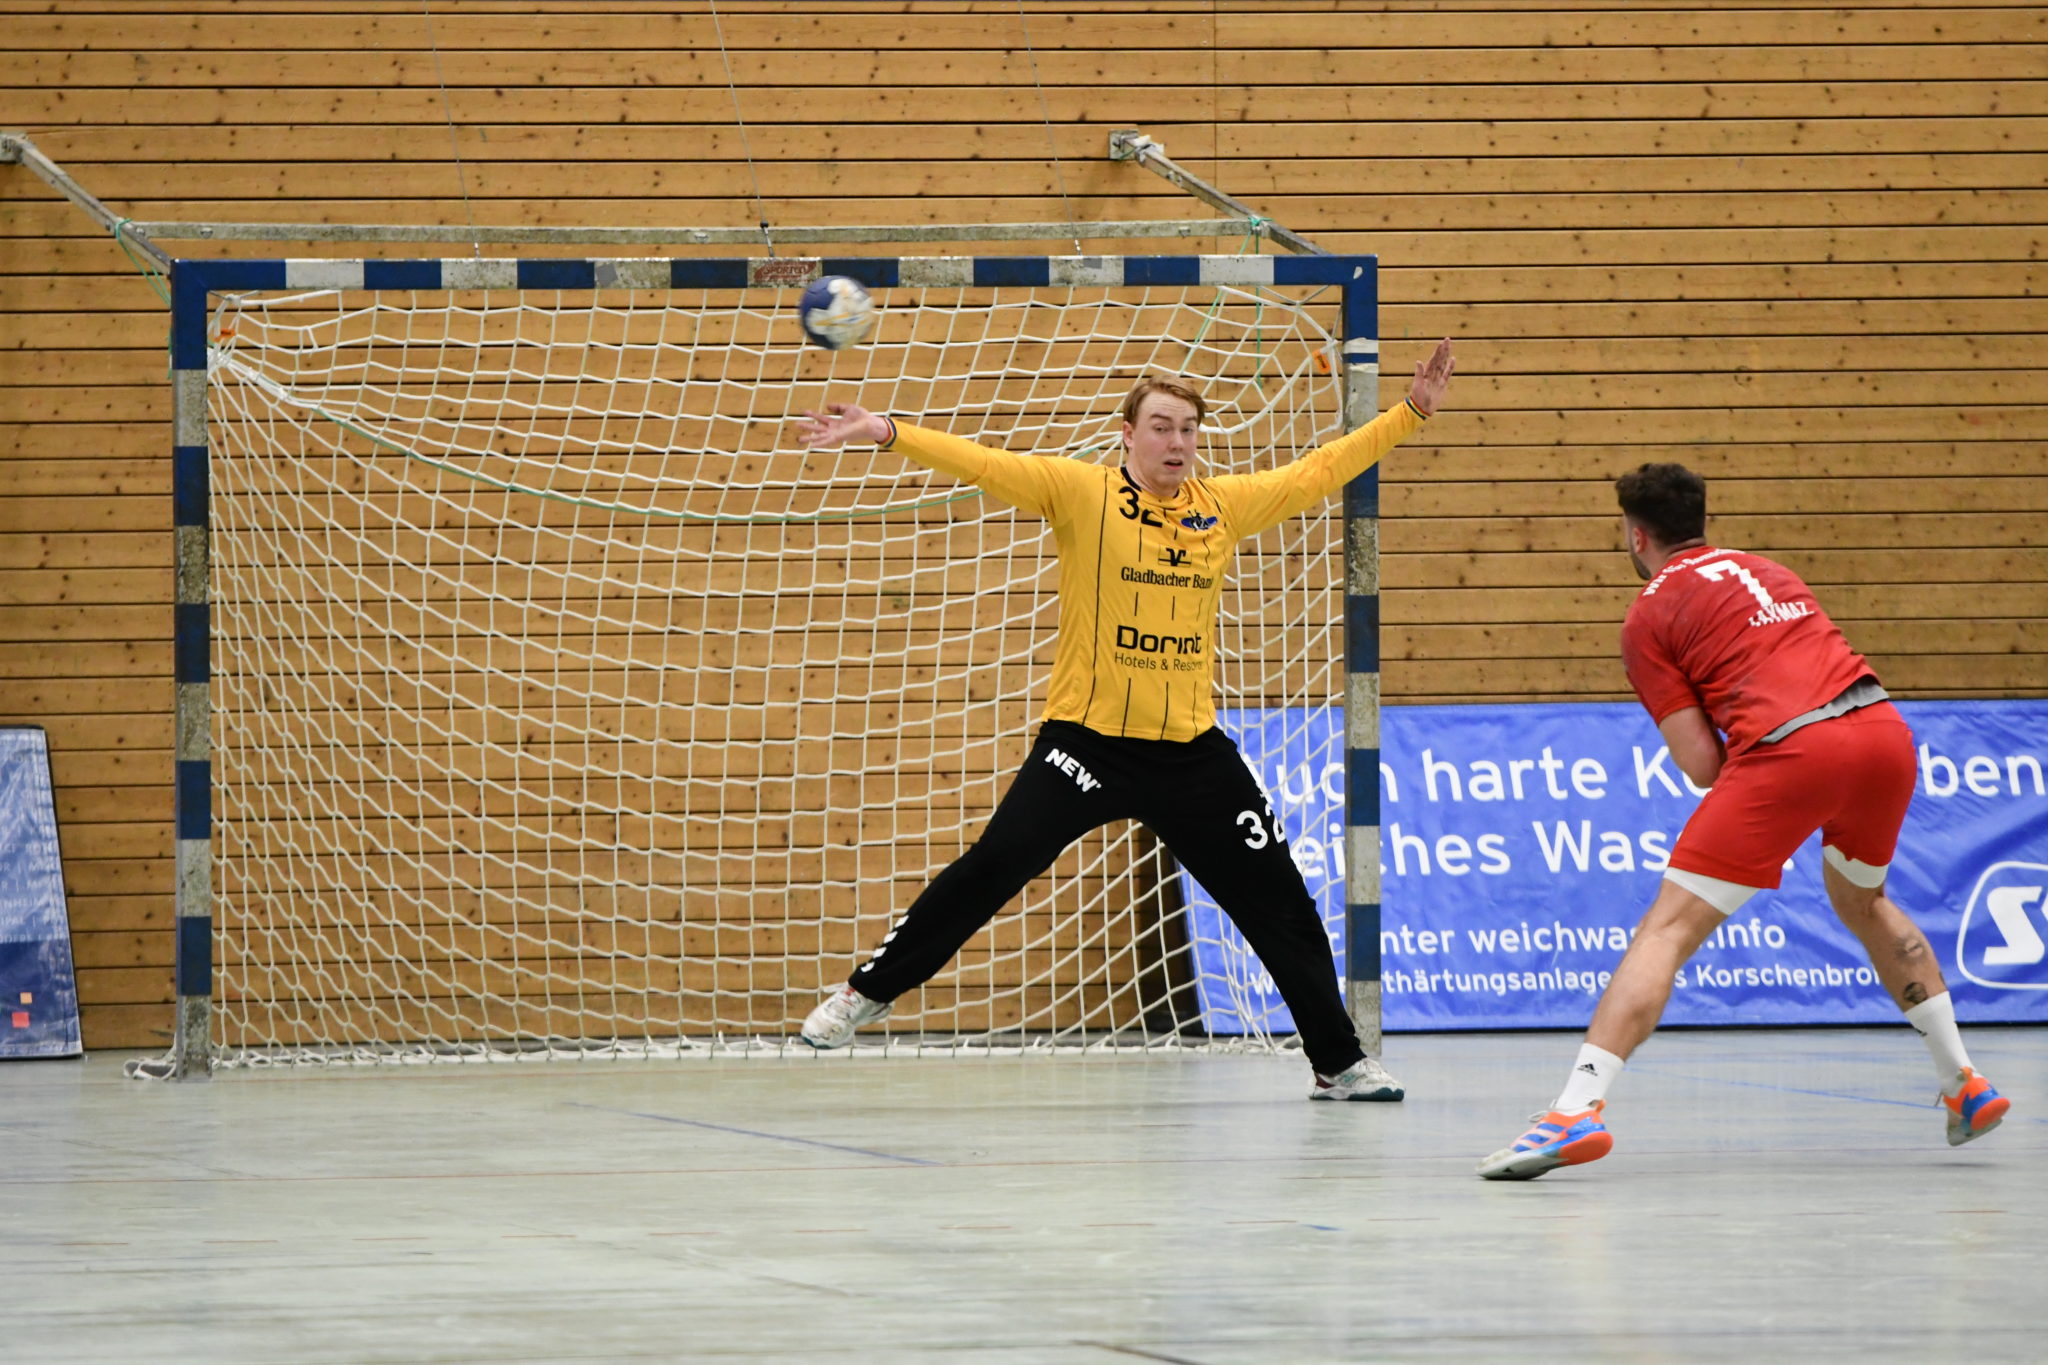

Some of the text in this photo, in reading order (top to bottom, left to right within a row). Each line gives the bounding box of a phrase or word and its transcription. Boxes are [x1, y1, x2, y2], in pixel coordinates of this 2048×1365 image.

[1121, 566, 1214, 589] Gladbacher Ban
[1695, 559, 1773, 608] 7
[1116, 624, 1202, 655] Dorint
[1114, 651, 1157, 670] Hotels
[1160, 658, 1168, 671] &
[1421, 745, 1608, 802] harte
[1918, 742, 2046, 797] ben
[1380, 923, 1455, 955] nter
